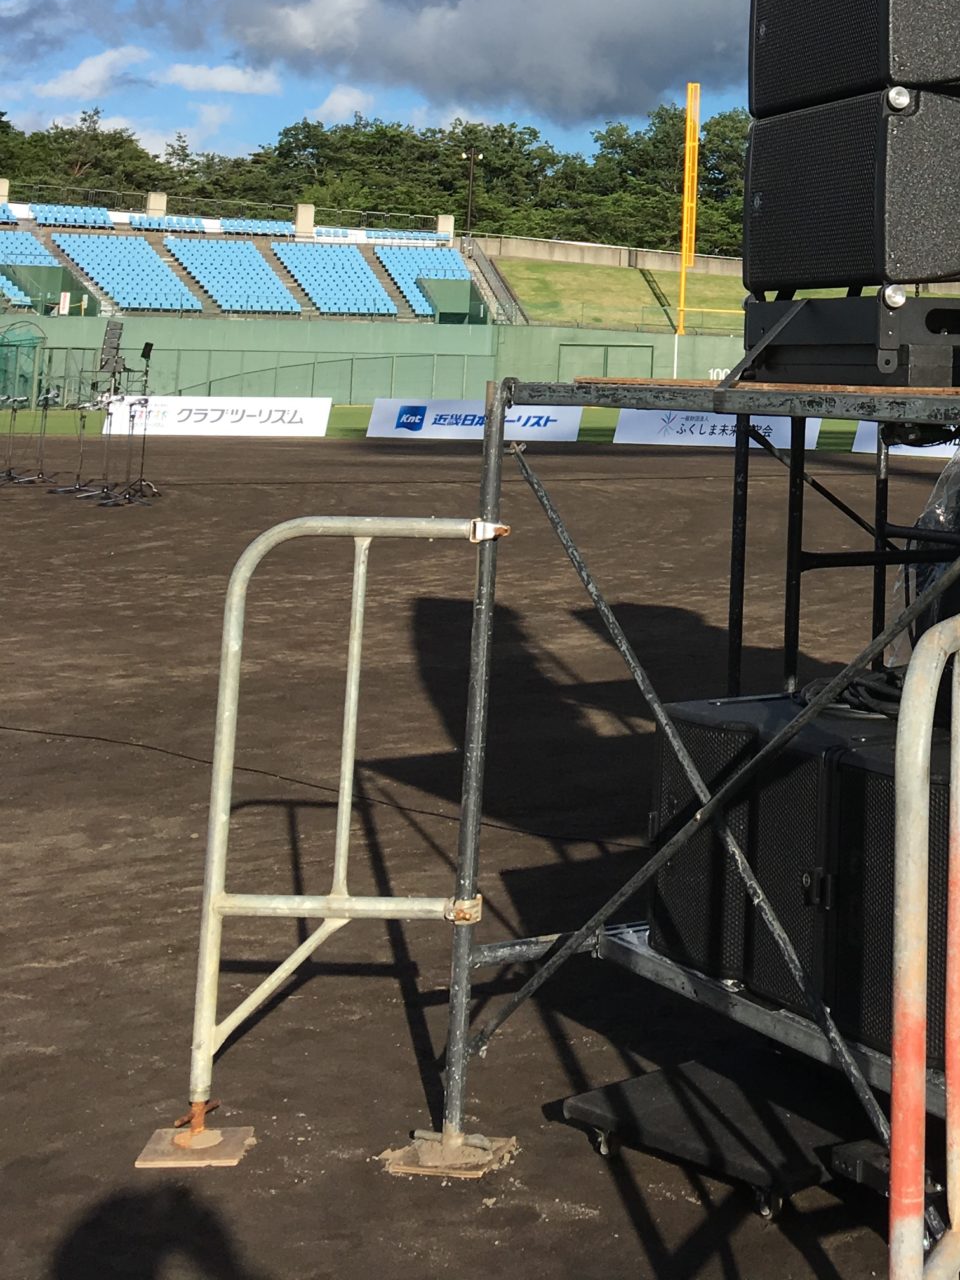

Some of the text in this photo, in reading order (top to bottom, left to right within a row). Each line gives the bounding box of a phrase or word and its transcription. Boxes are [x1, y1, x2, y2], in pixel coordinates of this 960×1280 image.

[177, 408, 304, 424] クラブツーリズム
[400, 414, 422, 424] Knt
[432, 413, 558, 427] 近畿日本ーリスト
